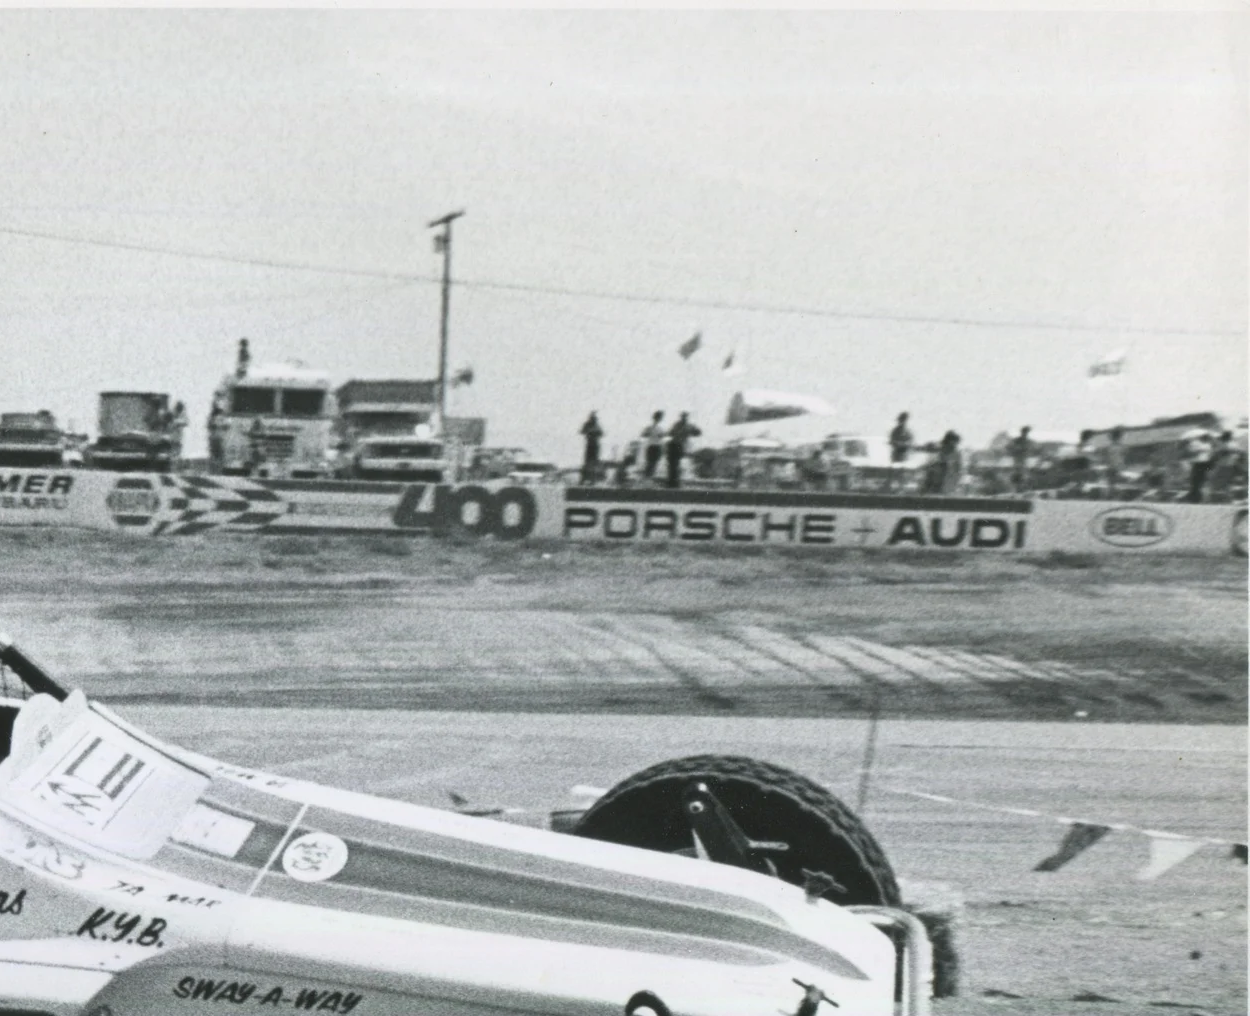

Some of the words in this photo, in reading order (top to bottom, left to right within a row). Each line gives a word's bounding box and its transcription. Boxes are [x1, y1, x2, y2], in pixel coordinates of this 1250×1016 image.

[393, 485, 538, 541] 400
[565, 507, 836, 544] PORSCHE
[887, 517, 1029, 549] AUDI
[1103, 516, 1162, 537] BELL
[172, 975, 364, 1015] SWAY-A-WAY
